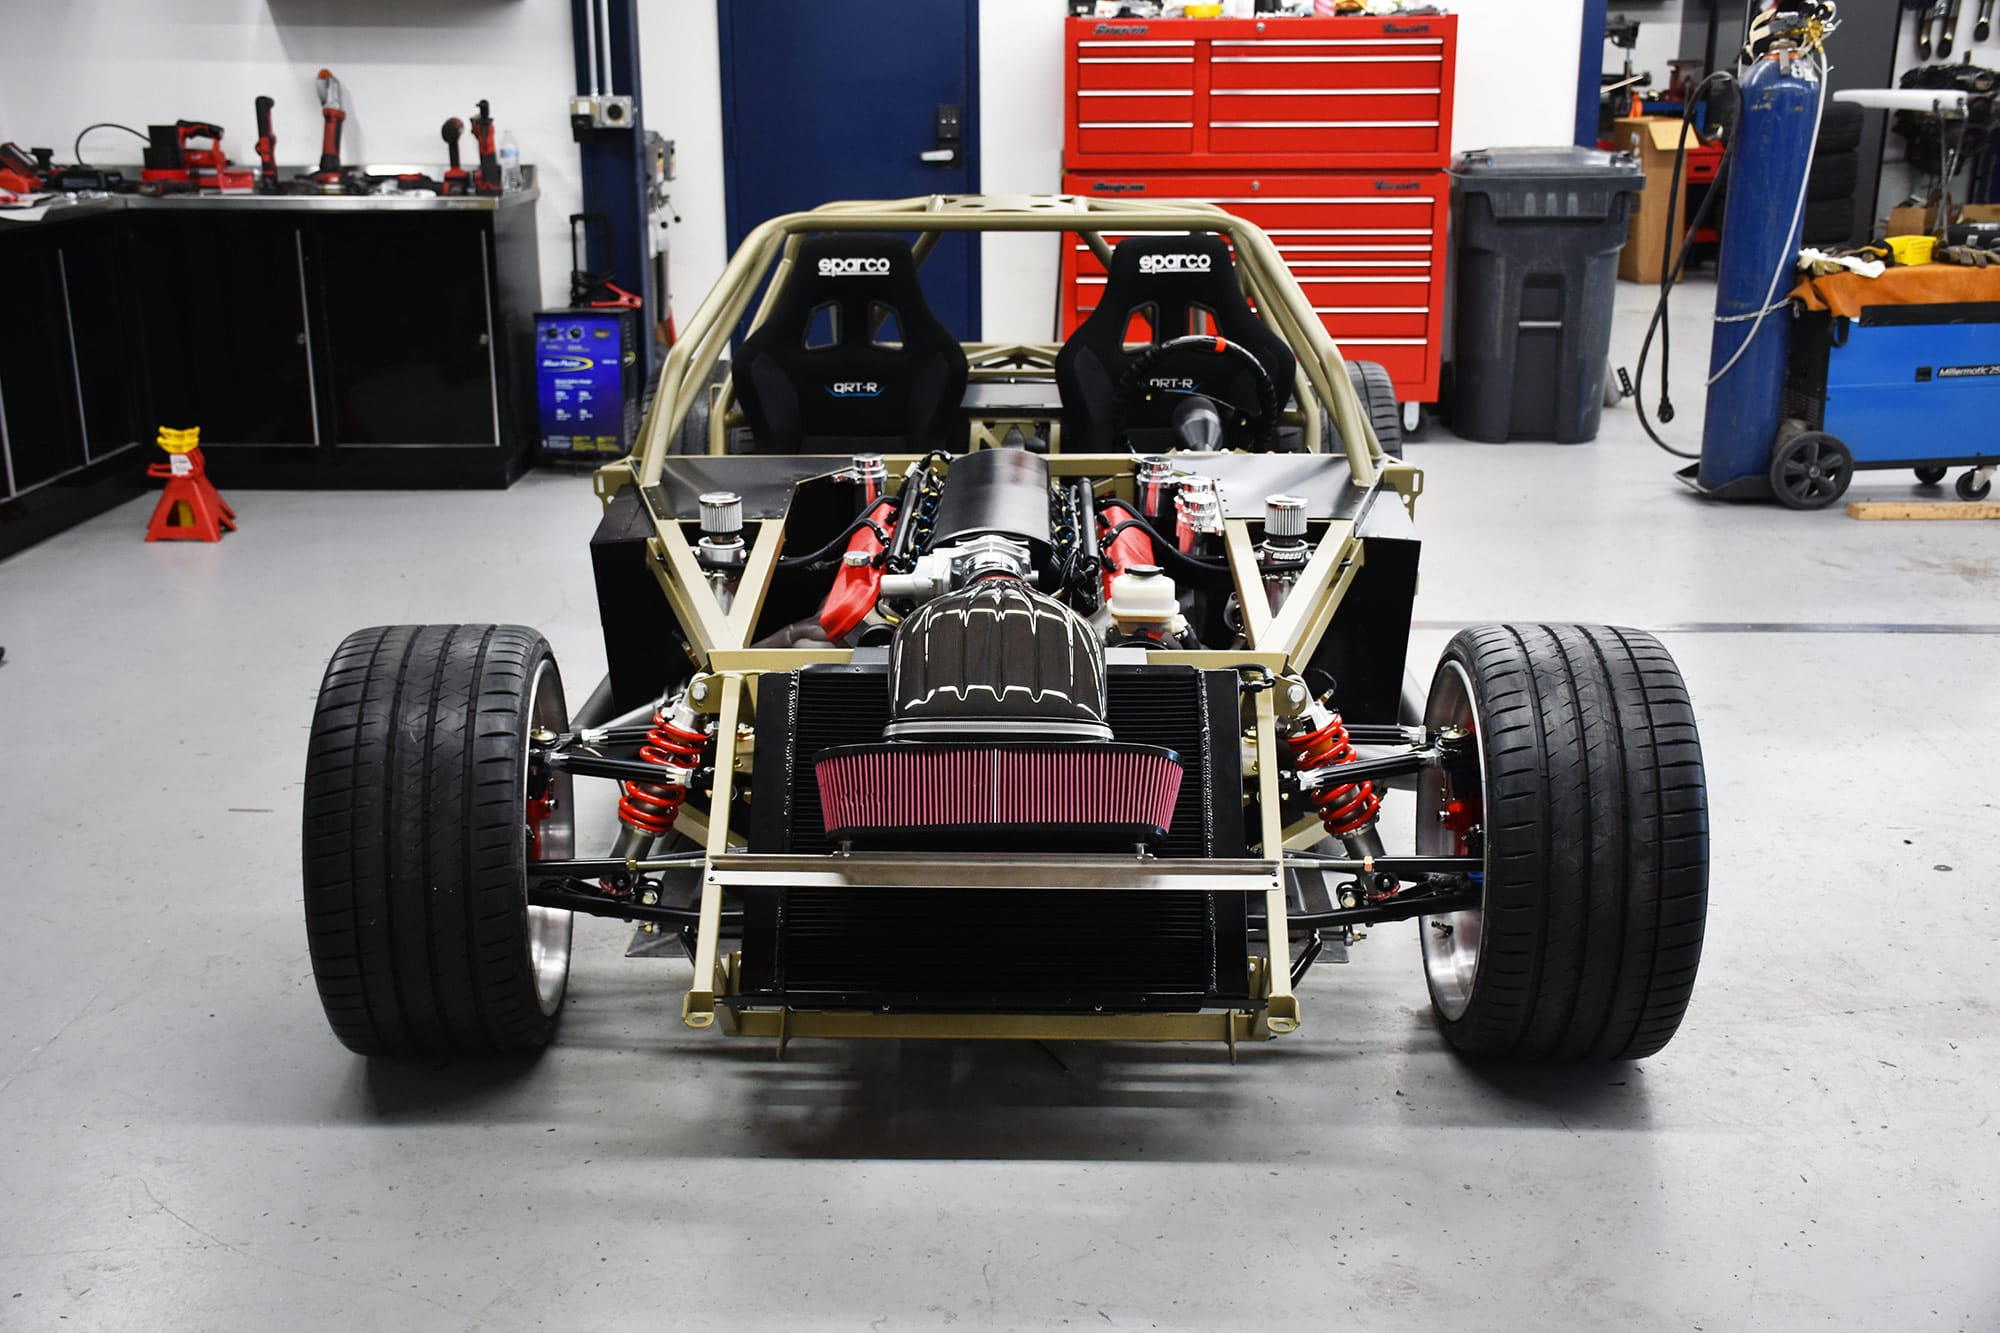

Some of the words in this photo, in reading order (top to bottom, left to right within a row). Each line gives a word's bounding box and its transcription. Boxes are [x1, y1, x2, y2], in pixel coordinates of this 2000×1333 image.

[818, 257, 891, 277] sparco
[1139, 254, 1211, 274] sparco
[1938, 366, 1987, 377] Millermatic
[833, 382, 878, 394] QRT-R
